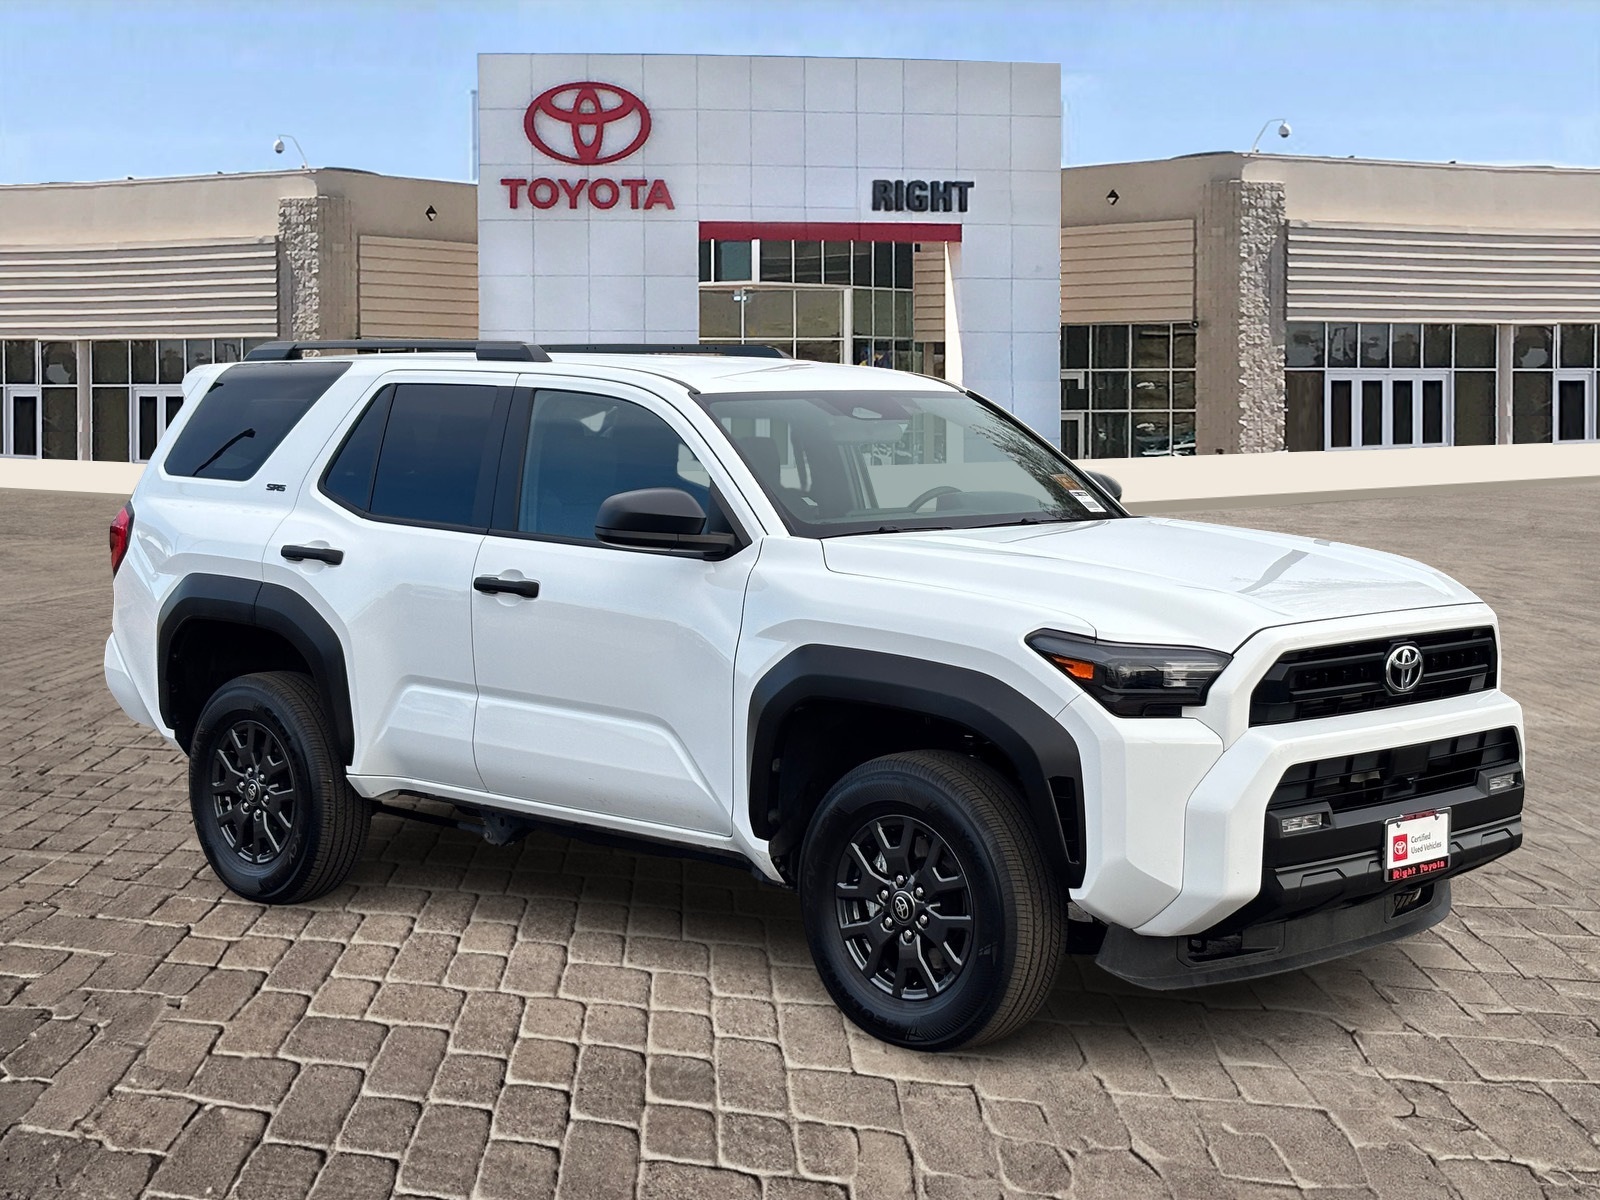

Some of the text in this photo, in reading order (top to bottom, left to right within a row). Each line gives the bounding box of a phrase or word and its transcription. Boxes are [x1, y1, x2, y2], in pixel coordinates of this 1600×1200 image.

[500, 178, 676, 210] TOYOTA
[872, 179, 975, 212] RIGHT
[1411, 832, 1431, 843] Certified
[1411, 841, 1442, 854] Used Vehicles
[1393, 867, 1416, 879] Right
